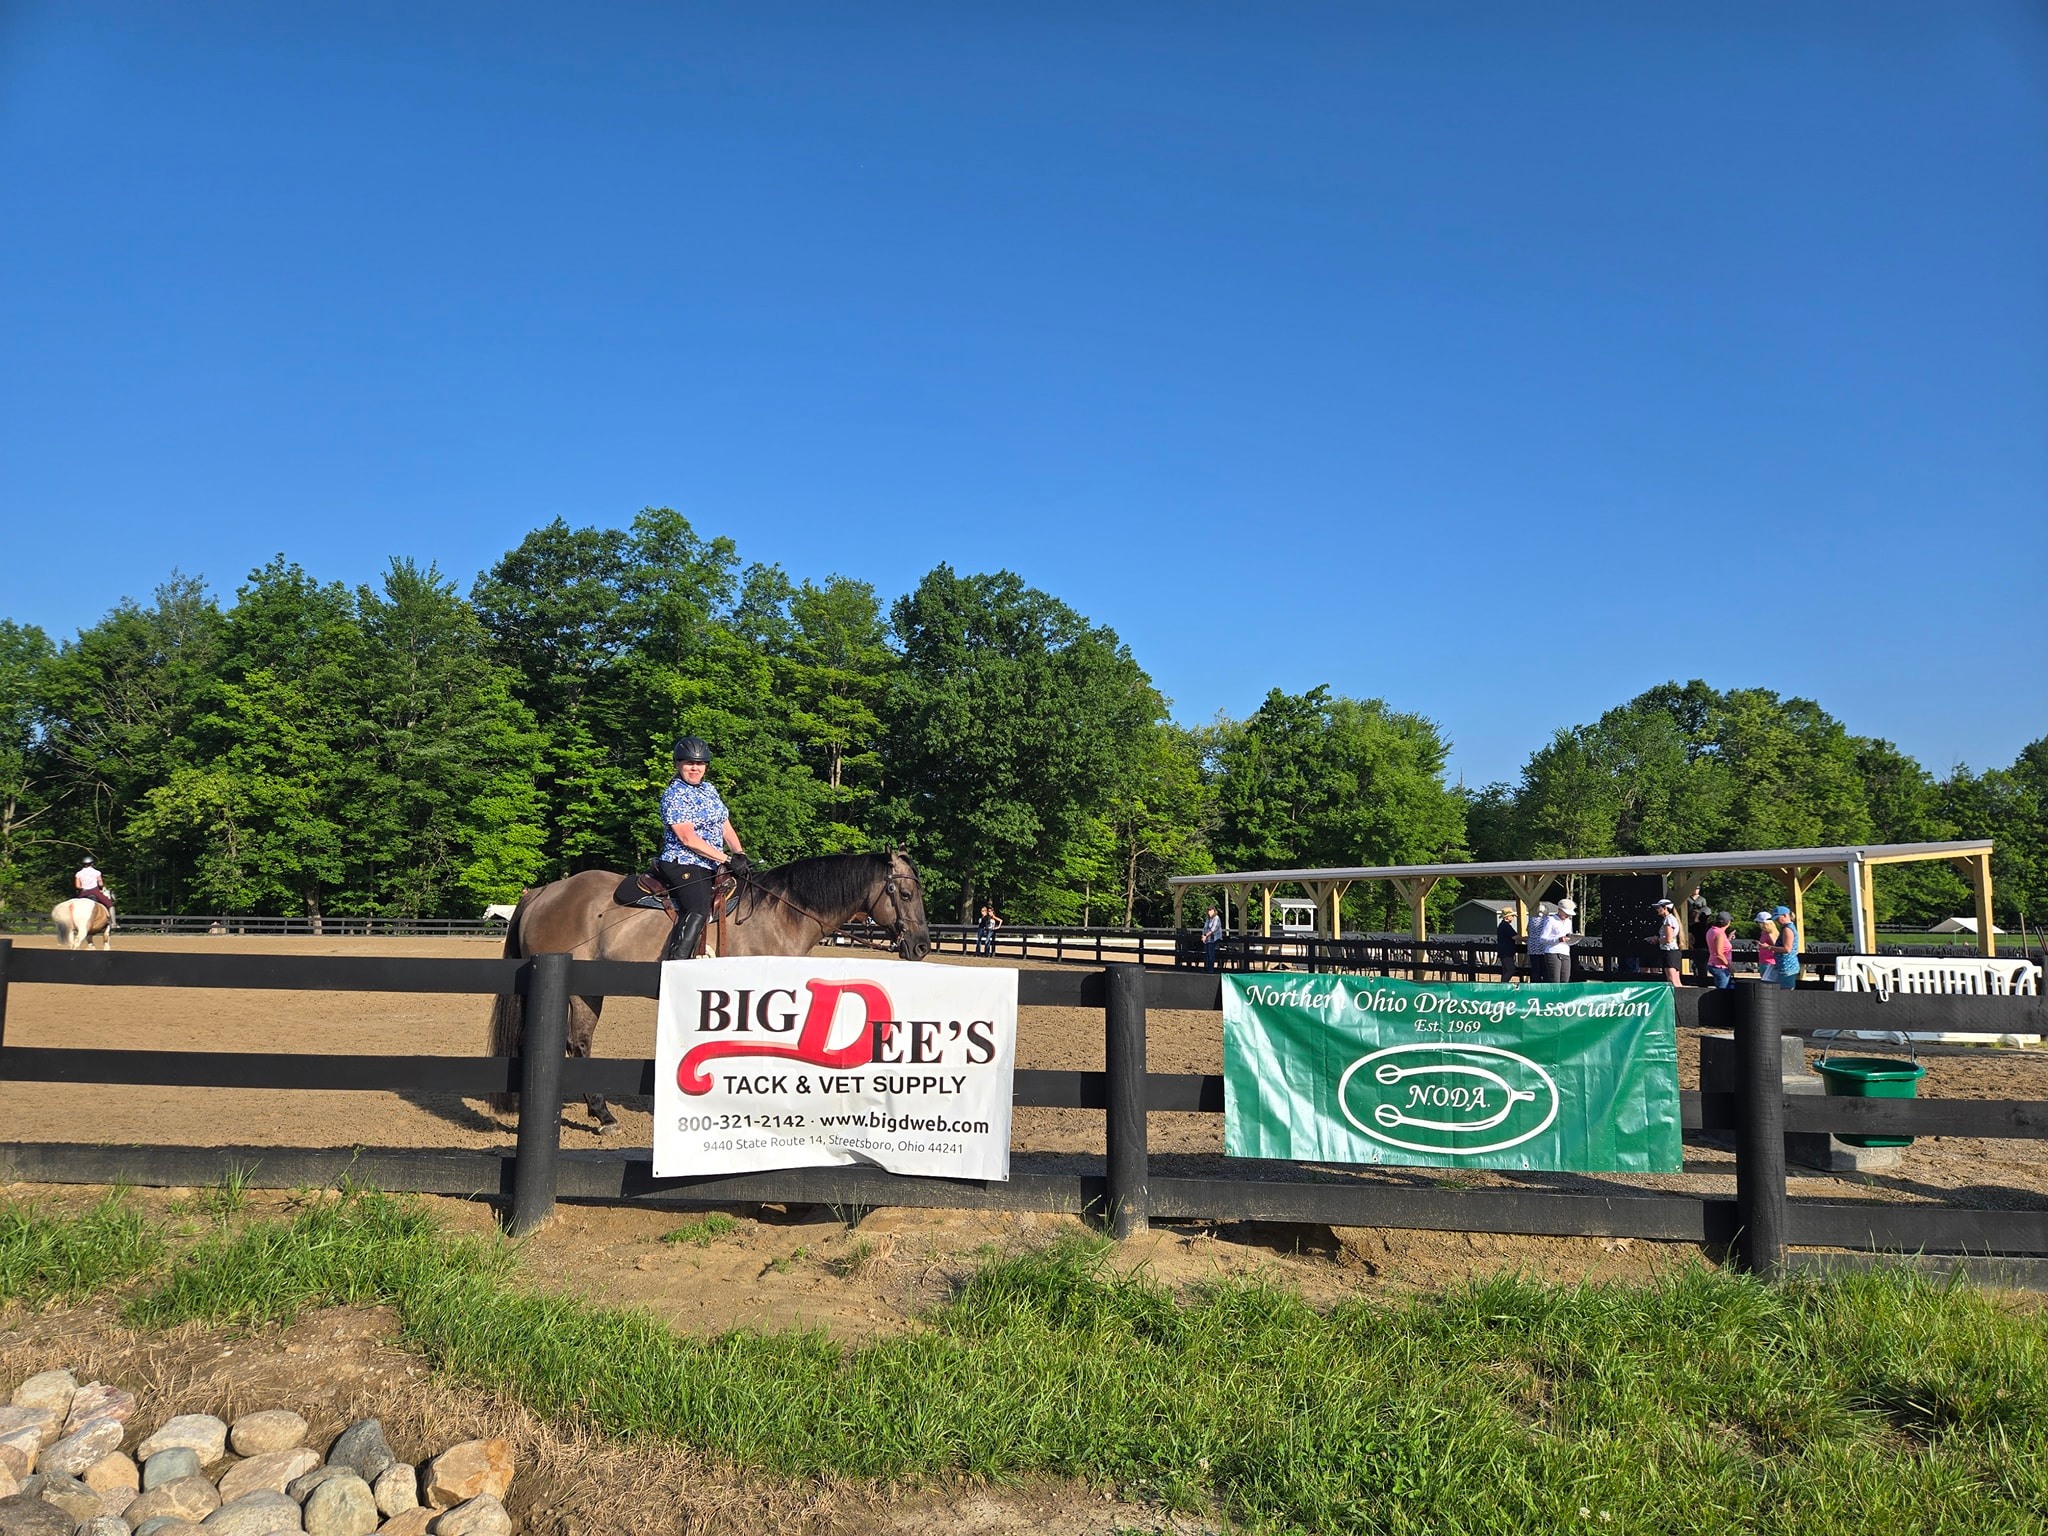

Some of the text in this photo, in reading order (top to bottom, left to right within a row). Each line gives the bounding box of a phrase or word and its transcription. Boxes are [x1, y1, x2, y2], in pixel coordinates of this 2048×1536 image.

[1353, 989, 1407, 1013] Ohio
[1414, 993, 1516, 1023] Dressage
[1520, 997, 1651, 1020] Association
[694, 977, 996, 1070] BIG DEE'S
[1414, 1019, 1481, 1034] Est. 1969
[723, 1075, 967, 1095] TACK & VET SUPPLY
[1405, 1085, 1491, 1110] N.O.D.A.
[677, 1111, 989, 1134] 800-321-2142 www.bigdweb.com
[703, 1135, 963, 1154] 9440 State Route 14, Streetsboro, Ohio 44241
